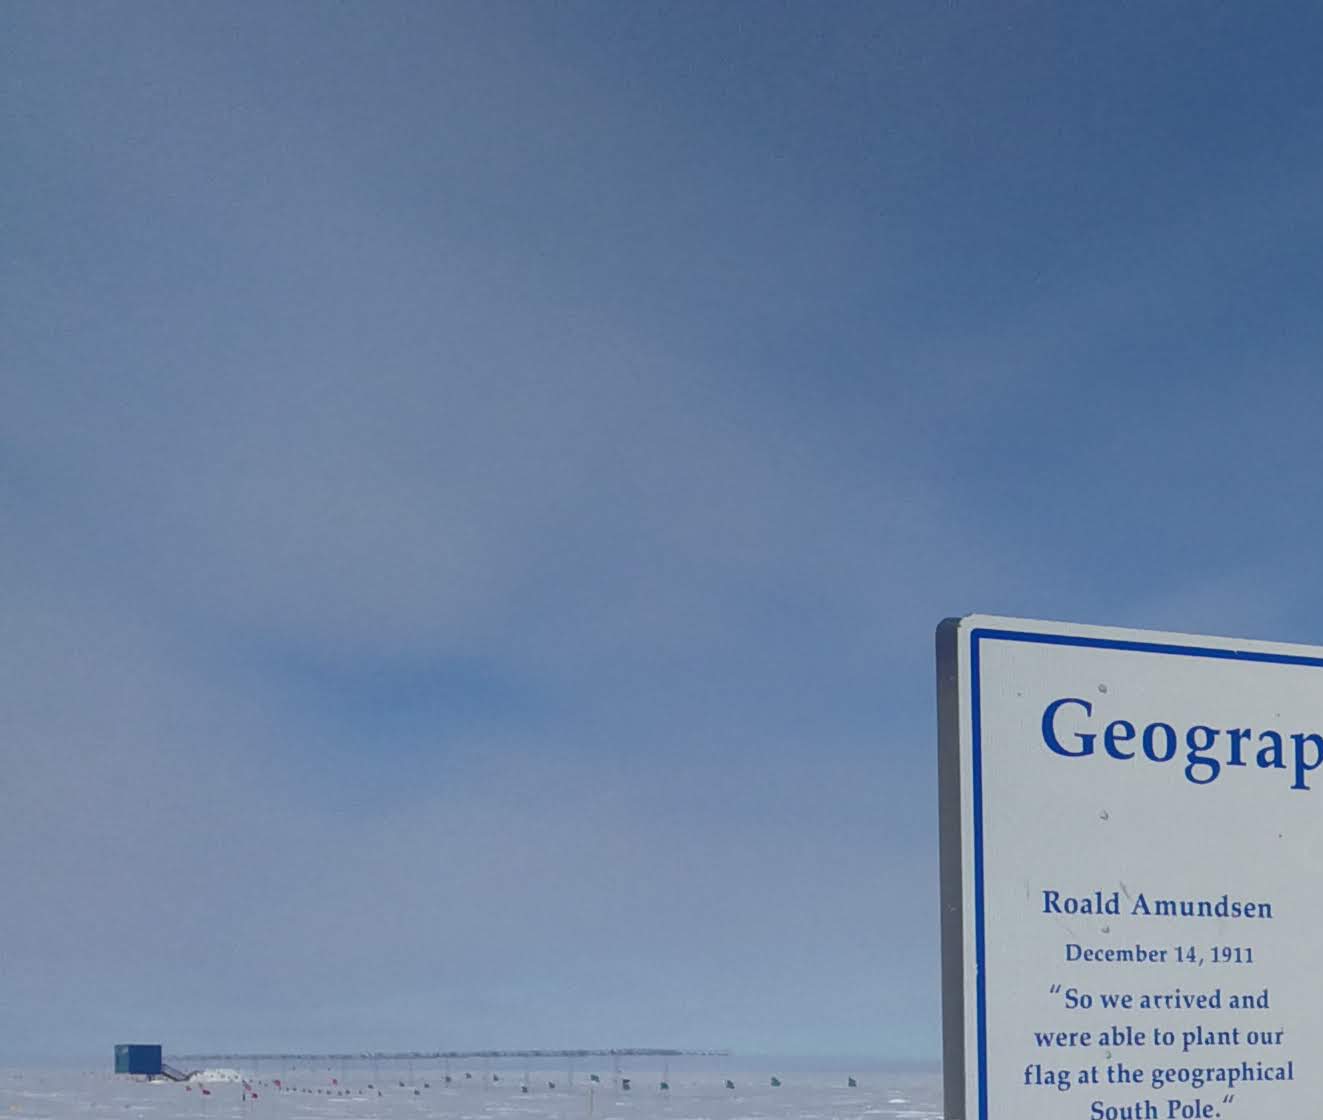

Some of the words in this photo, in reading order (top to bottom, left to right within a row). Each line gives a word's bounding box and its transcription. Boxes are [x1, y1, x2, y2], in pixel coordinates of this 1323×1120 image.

[1042, 890, 1121, 915] Roald
[1131, 893, 1273, 919] Amundsen
[1065, 943, 1168, 963] December
[1174, 945, 1204, 967] 14,
[1211, 946, 1254, 964] 1911
[1100, 994, 1133, 1009] we
[1139, 988, 1222, 1009] arrived
[1228, 988, 1270, 1009] and
[1034, 1031, 1092, 1047] were
[1098, 1025, 1146, 1047] able
[1153, 1028, 1175, 1046] to
[1182, 1025, 1240, 1053] plant
[1246, 1030, 1284, 1046] our
[1023, 1063, 1072, 1092] flag
[1077, 1066, 1099, 1085] at
[1106, 1063, 1144, 1084] the
[1151, 1060, 1295, 1090] geographical
